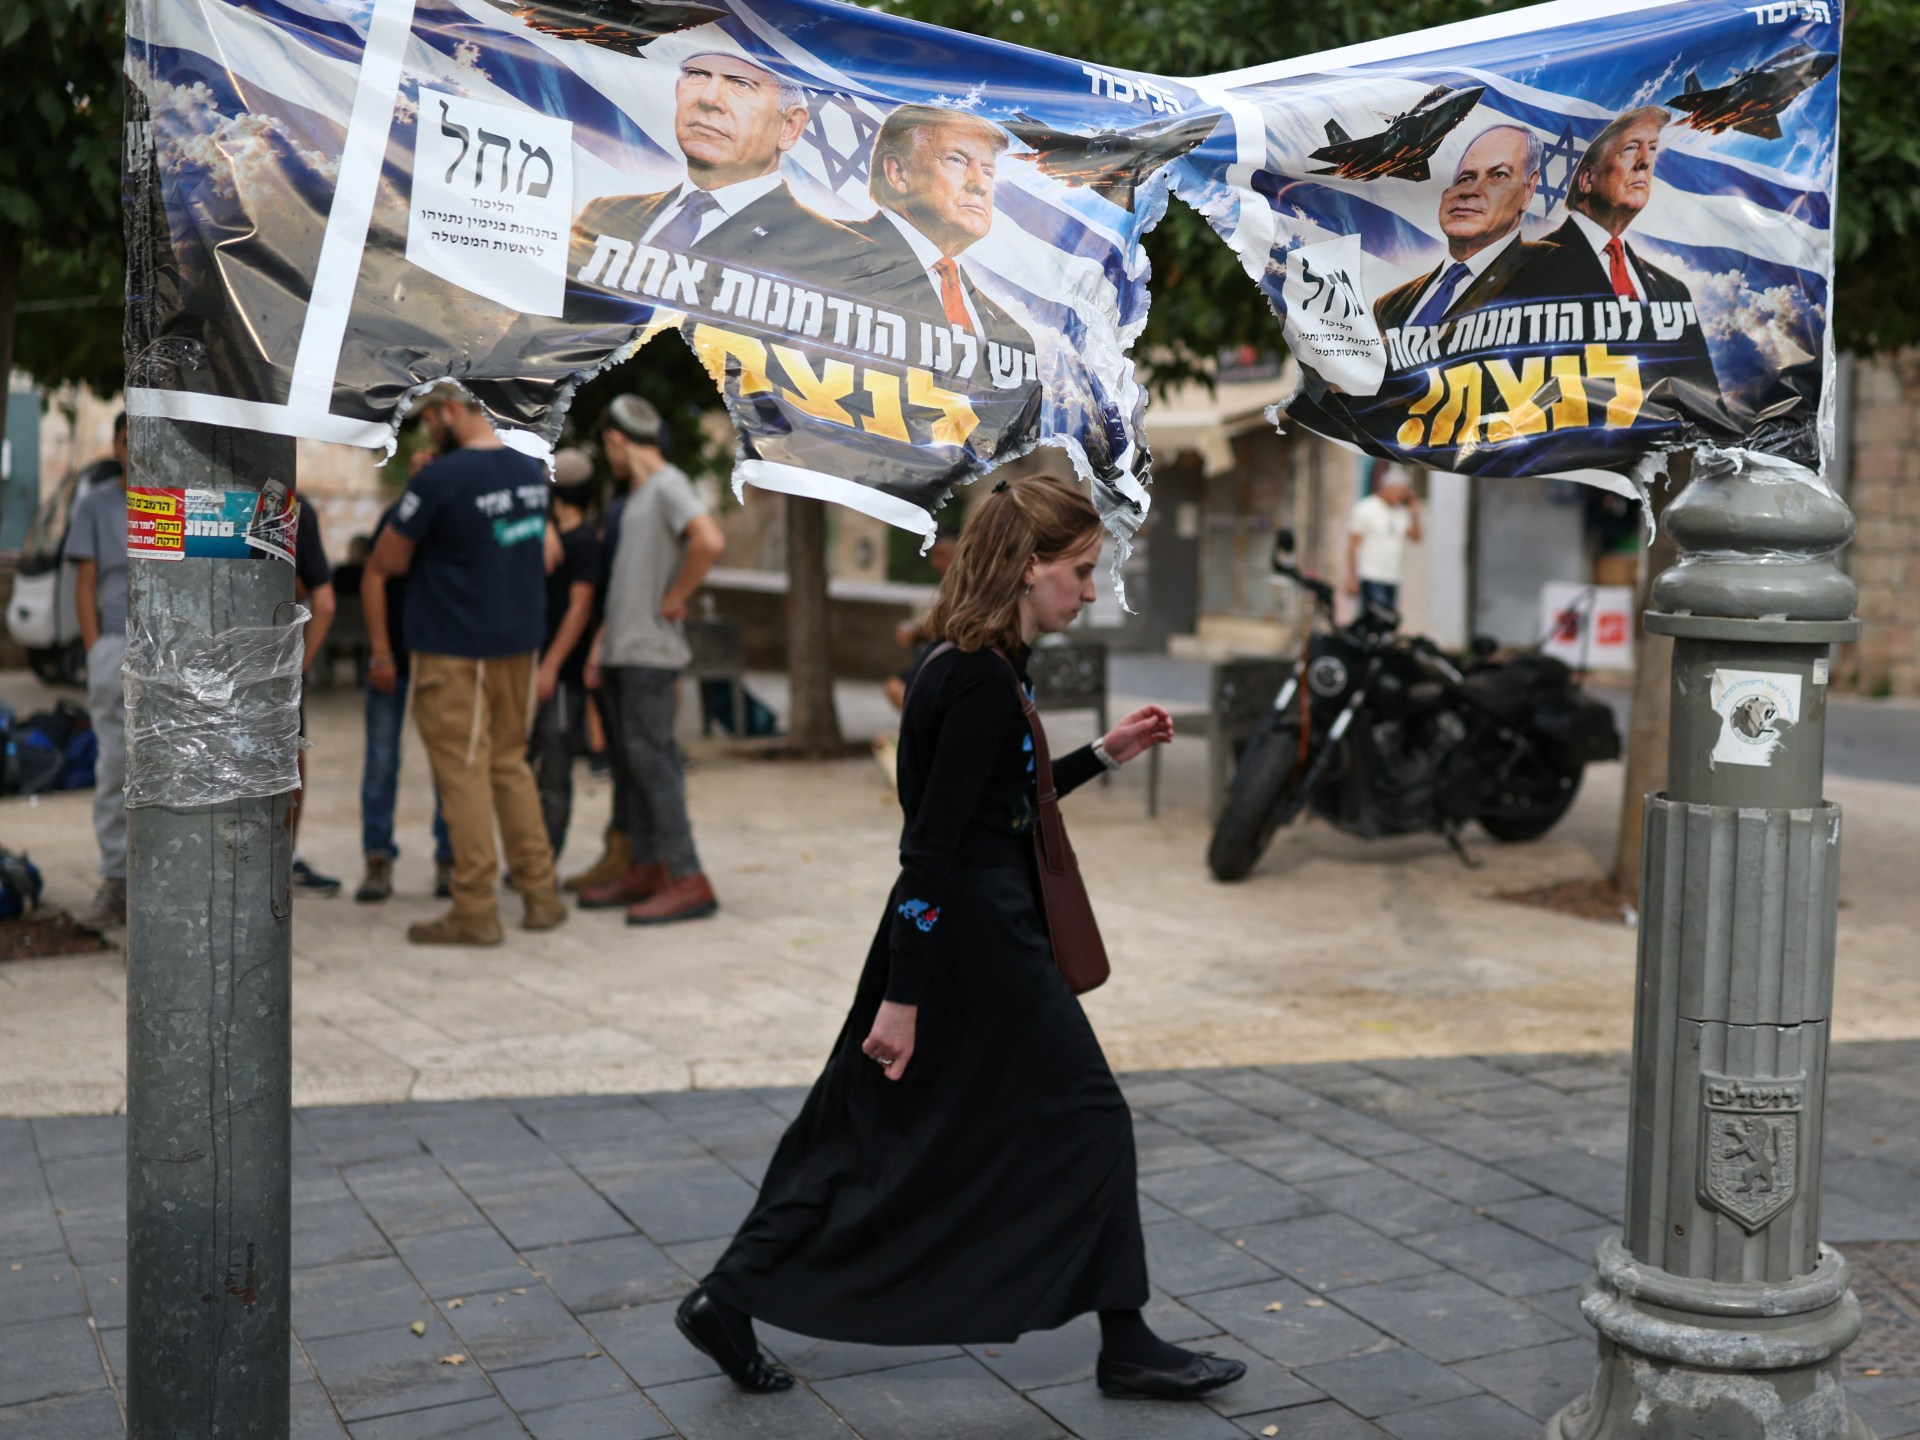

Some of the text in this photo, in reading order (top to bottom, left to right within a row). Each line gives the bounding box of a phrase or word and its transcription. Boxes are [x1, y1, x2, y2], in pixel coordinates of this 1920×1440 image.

[438, 99, 554, 198] מחל
[470, 197, 514, 213] הליכוד
[422, 209, 558, 240] בהנהגת בנימין נתניהו
[431, 231, 544, 256] לראשות הממשלה
[577, 234, 1038, 390] יש לנו הזדמנות אחת
[1319, 318, 1353, 332] הליכוד
[1385, 295, 1698, 371] יש לנו הזדמנות אחת
[1336, 348, 1372, 357] לראשות
[1396, 343, 1644, 450] לנצח!
[157, 522, 180, 532] זרקת
[156, 536, 180, 546] זרקת
[1707, 1080, 1801, 1108] ירושלים
